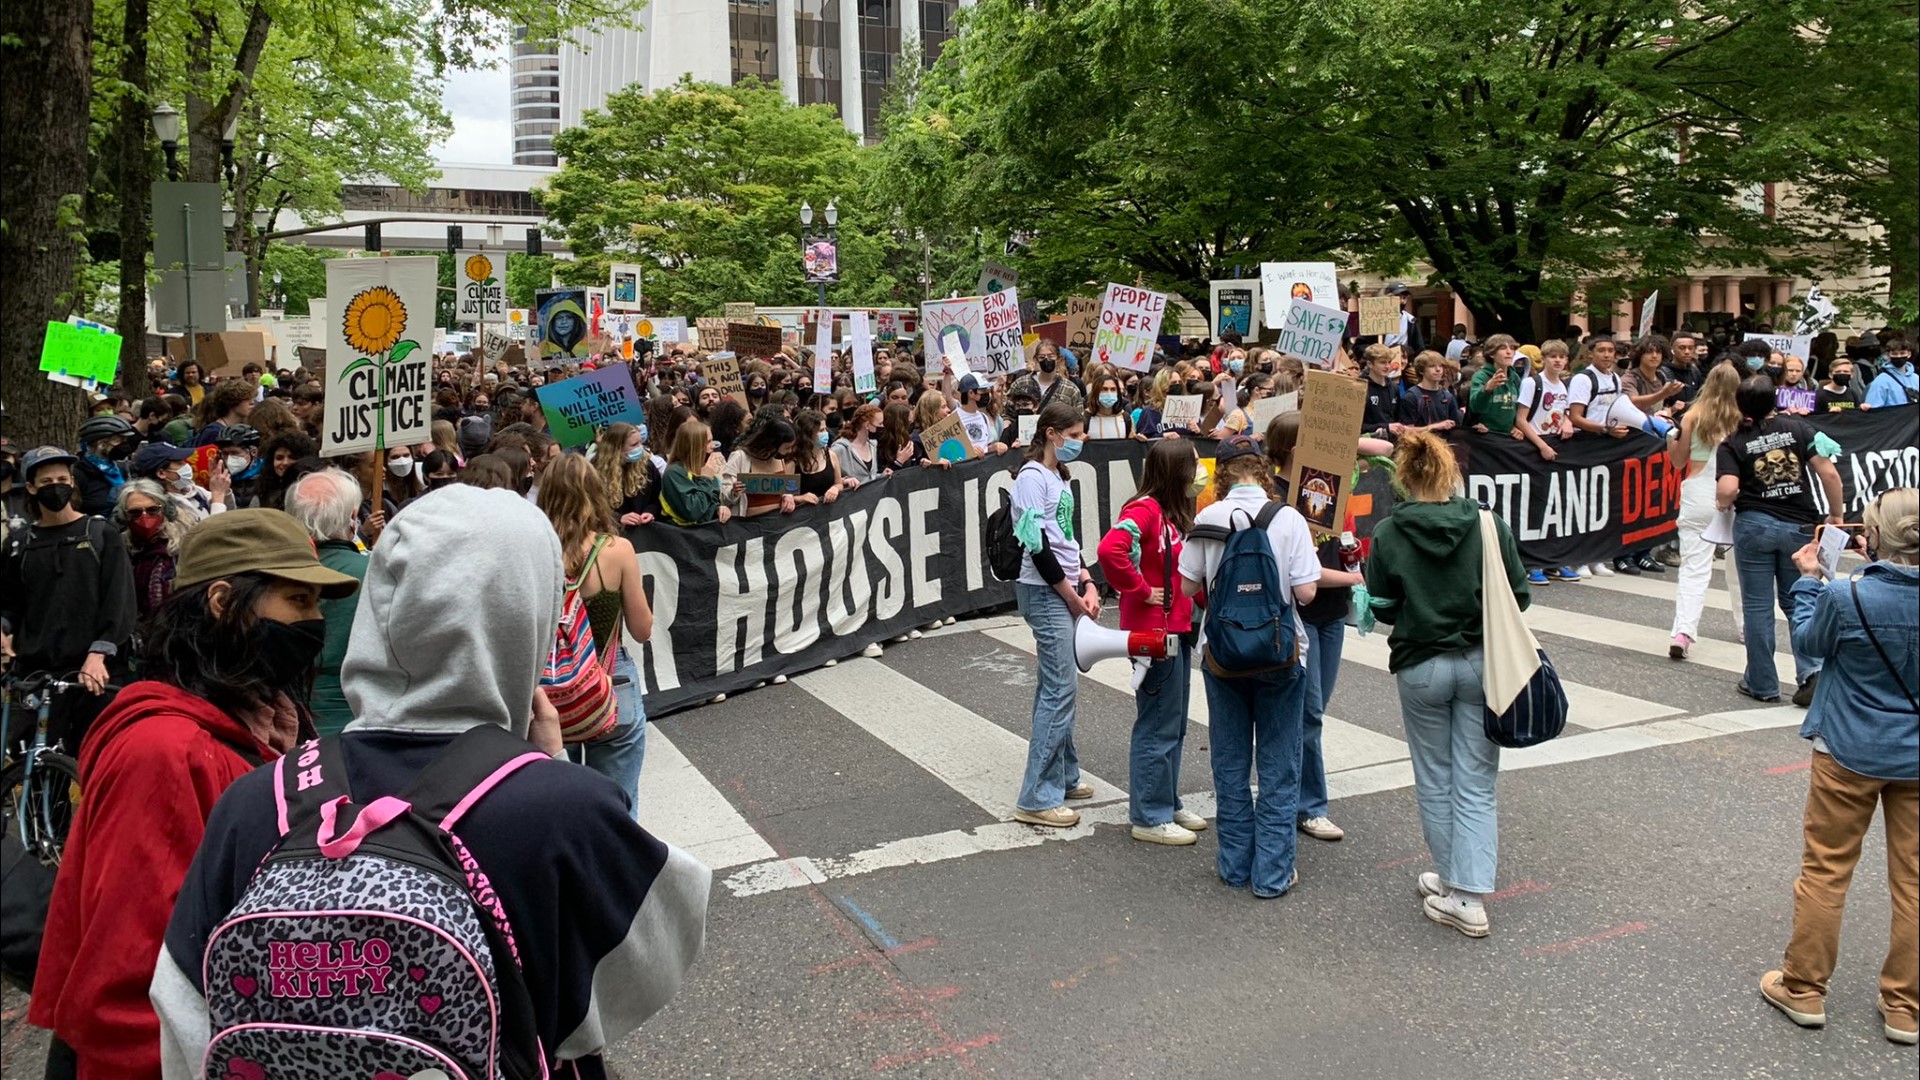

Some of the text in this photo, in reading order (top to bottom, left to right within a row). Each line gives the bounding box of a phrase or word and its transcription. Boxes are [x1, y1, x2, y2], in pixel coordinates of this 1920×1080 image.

[468, 287, 501, 299] CLIMATE
[983, 292, 1006, 312] END
[1111, 287, 1164, 312] PEOPLE
[461, 300, 501, 314] JUSTICE
[984, 304, 1018, 329] BBYING
[1102, 310, 1152, 332] OVER
[1286, 305, 1327, 335] SAVE
[1072, 331, 1096, 344] OI
[1095, 328, 1155, 357] PROFIT
[1769, 338, 1793, 351] SEEN
[706, 362, 732, 373] THIS
[987, 350, 1011, 374] ORP
[349, 361, 426, 400] CLIMATE
[708, 371, 740, 386] IS NOT
[573, 381, 603, 399] YOU
[721, 384, 744, 395] DRILL
[1308, 380, 1365, 400] THE ONLY
[1778, 388, 1817, 411] ORGANIZE
[558, 386, 626, 418] WILL NOT
[1311, 397, 1352, 418] GLOBAL
[332, 394, 424, 443] JUSTICE
[567, 402, 627, 429] SILENCE
[925, 439, 937, 452] ONE
[761, 477, 785, 493] CAP
[1461, 464, 1610, 541] RTLAND
[1850, 446, 1920, 512] ACTIO
[1301, 488, 1334, 505] PITBULL
[715, 487, 943, 677] HOUSE
[269, 965, 392, 999] KITTY
